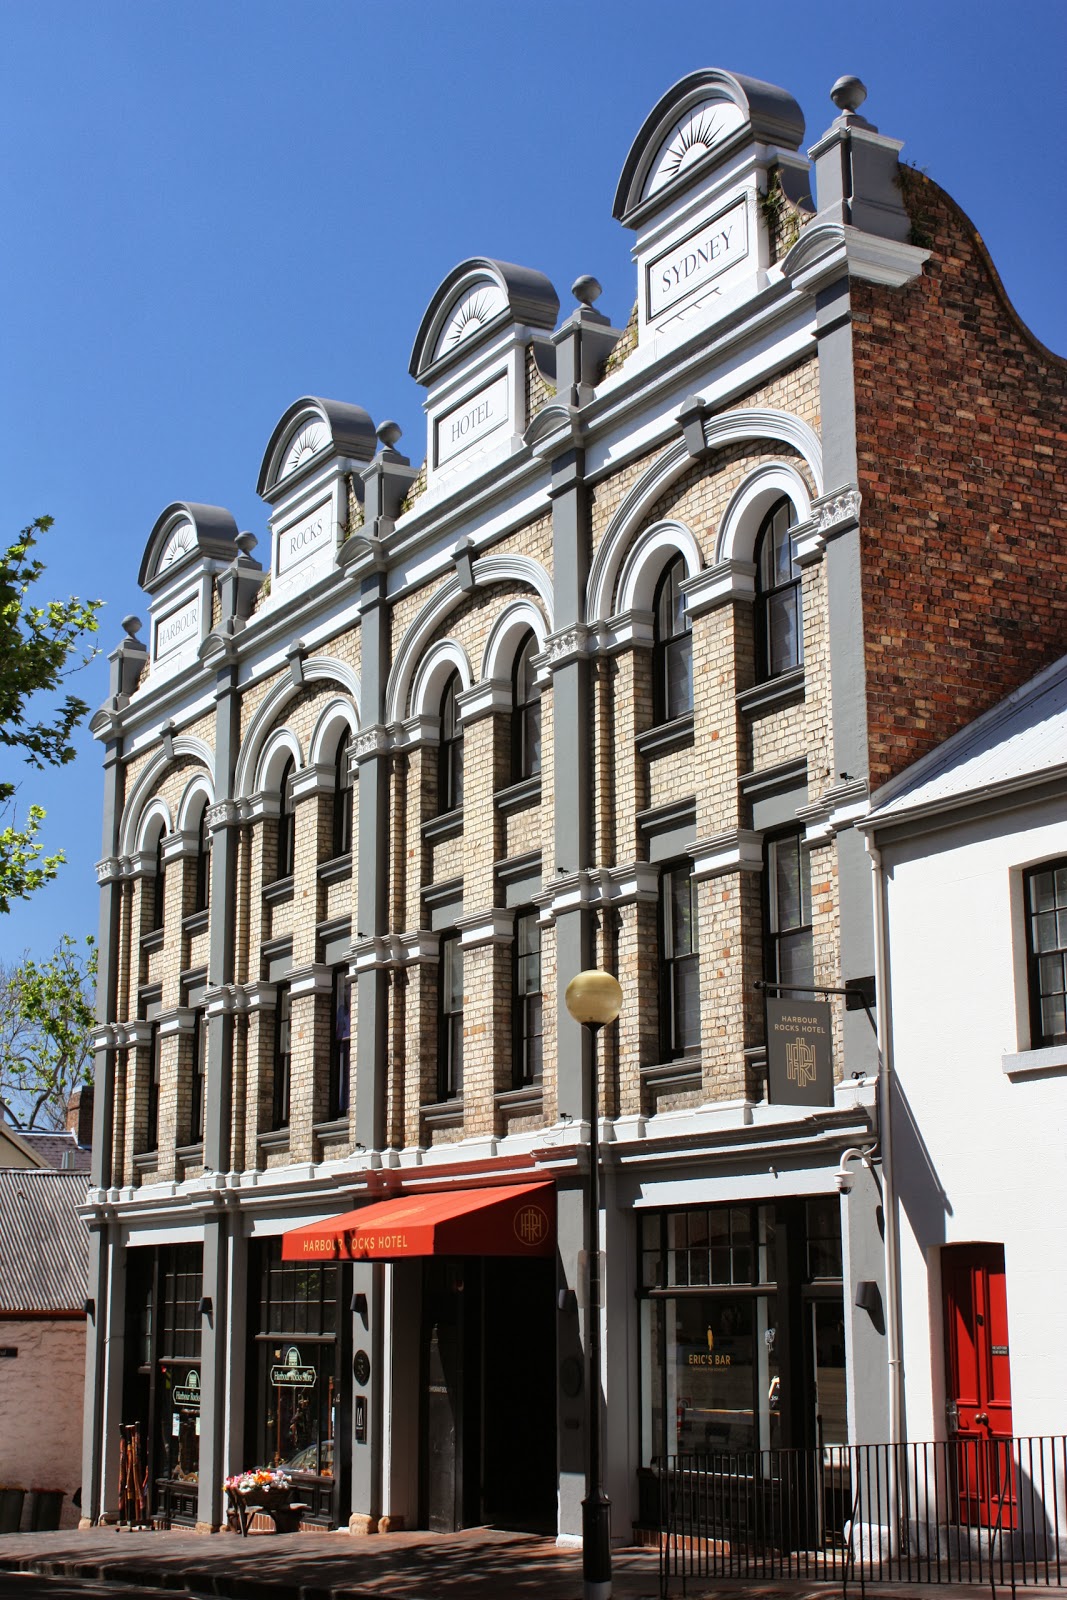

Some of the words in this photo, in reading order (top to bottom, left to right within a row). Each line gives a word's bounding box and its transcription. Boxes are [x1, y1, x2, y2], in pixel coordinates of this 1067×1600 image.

[662, 225, 733, 293] SYDNEY
[451, 400, 493, 442] HOTEL
[290, 518, 322, 554] ROCKS
[159, 608, 197, 646] HARBOUR
[774, 1023, 800, 1032] ROCKS
[801, 1025, 825, 1034] HOTEL
[781, 1015, 818, 1024] HARBOUR
[346, 1237, 375, 1250] OCKS
[378, 1235, 408, 1249] HOTEL
[688, 1354, 713, 1365] ERIC'S
[714, 1354, 731, 1365] BAR
